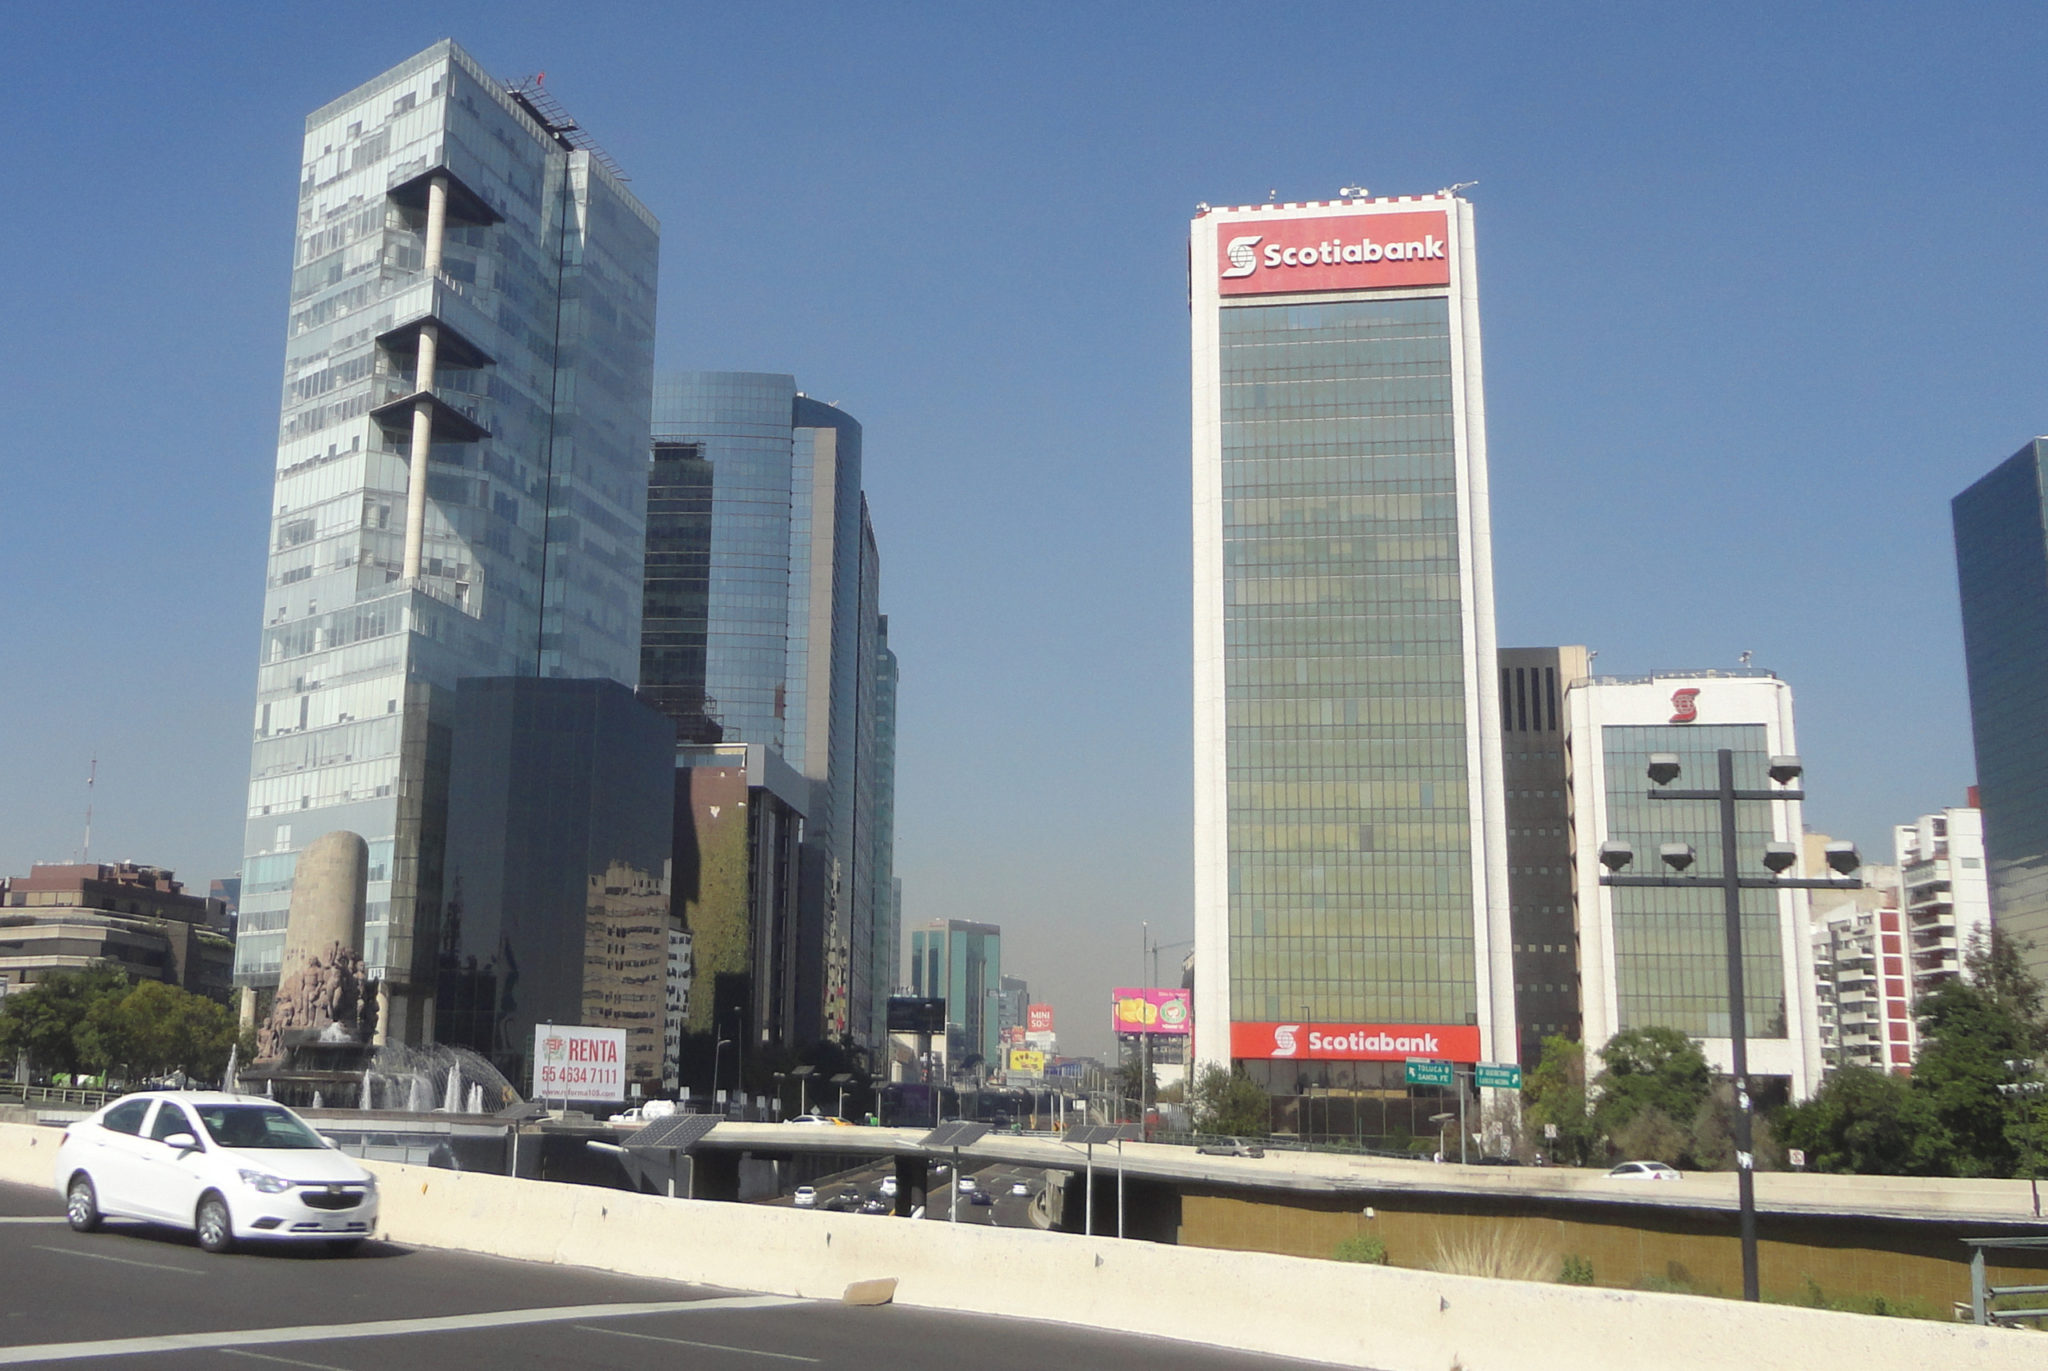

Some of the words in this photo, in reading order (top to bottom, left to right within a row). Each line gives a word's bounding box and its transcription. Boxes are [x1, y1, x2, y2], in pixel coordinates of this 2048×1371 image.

[1263, 235, 1445, 267] Scotiabank
[1031, 1011, 1050, 1019] MINI
[569, 1039, 617, 1062] RENTA
[1308, 1031, 1439, 1054] Scotiabank
[542, 1066, 556, 1081] 55
[559, 1067, 587, 1083] 4634
[590, 1067, 617, 1084] 7111
[1417, 1065, 1442, 1073] TOLUCA
